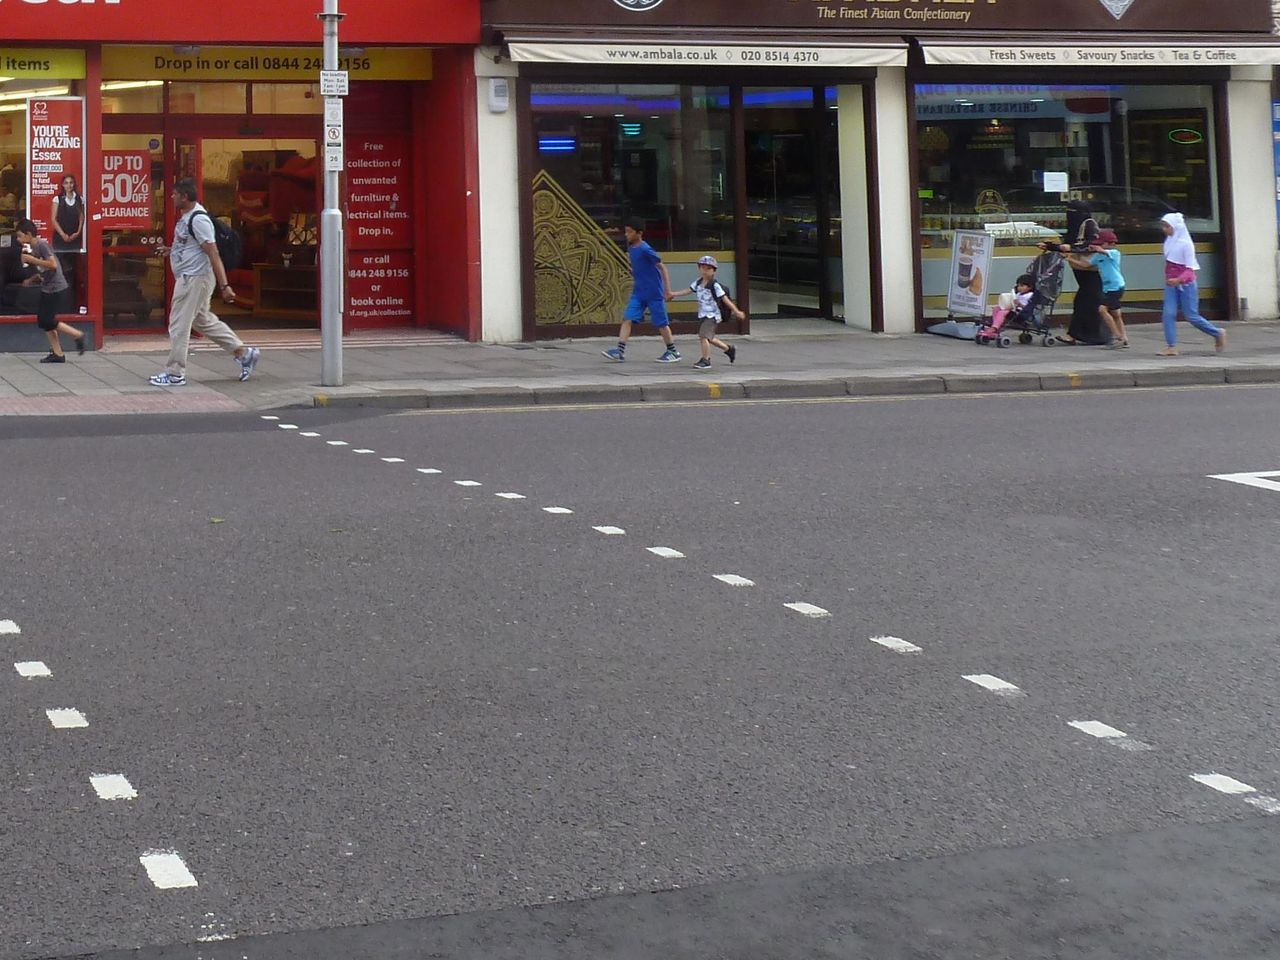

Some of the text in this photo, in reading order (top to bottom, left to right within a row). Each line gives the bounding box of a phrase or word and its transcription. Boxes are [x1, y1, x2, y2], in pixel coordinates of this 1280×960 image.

[816, 6, 971, 23] The Finest Asian Confectionery
[606, 48, 819, 62] www.ambala.co.uk 020 8514 4370
[989, 49, 1237, 62] Fresh Sweets Savoury Snacks Tea & Coffee
[6, 56, 50, 71] items
[154, 56, 370, 72] Drop in or call 0844 24 9156
[31, 125, 70, 137] YOU'RE
[31, 136, 81, 149] AMAZING
[363, 142, 384, 151] Free
[31, 148, 62, 161] Essex
[103, 155, 143, 171] UP TO
[347, 157, 401, 168] collection of
[352, 175, 397, 185] unwanted
[101, 172, 149, 204] 50% OFF
[351, 192, 400, 202] furniture &
[346, 209, 382, 219] lectrical
[358, 226, 381, 237] Drop
[362, 254, 390, 264] or call
[348, 268, 409, 278] 844 248 9156
[370, 284, 381, 292] or
[350, 296, 403, 306] book online
